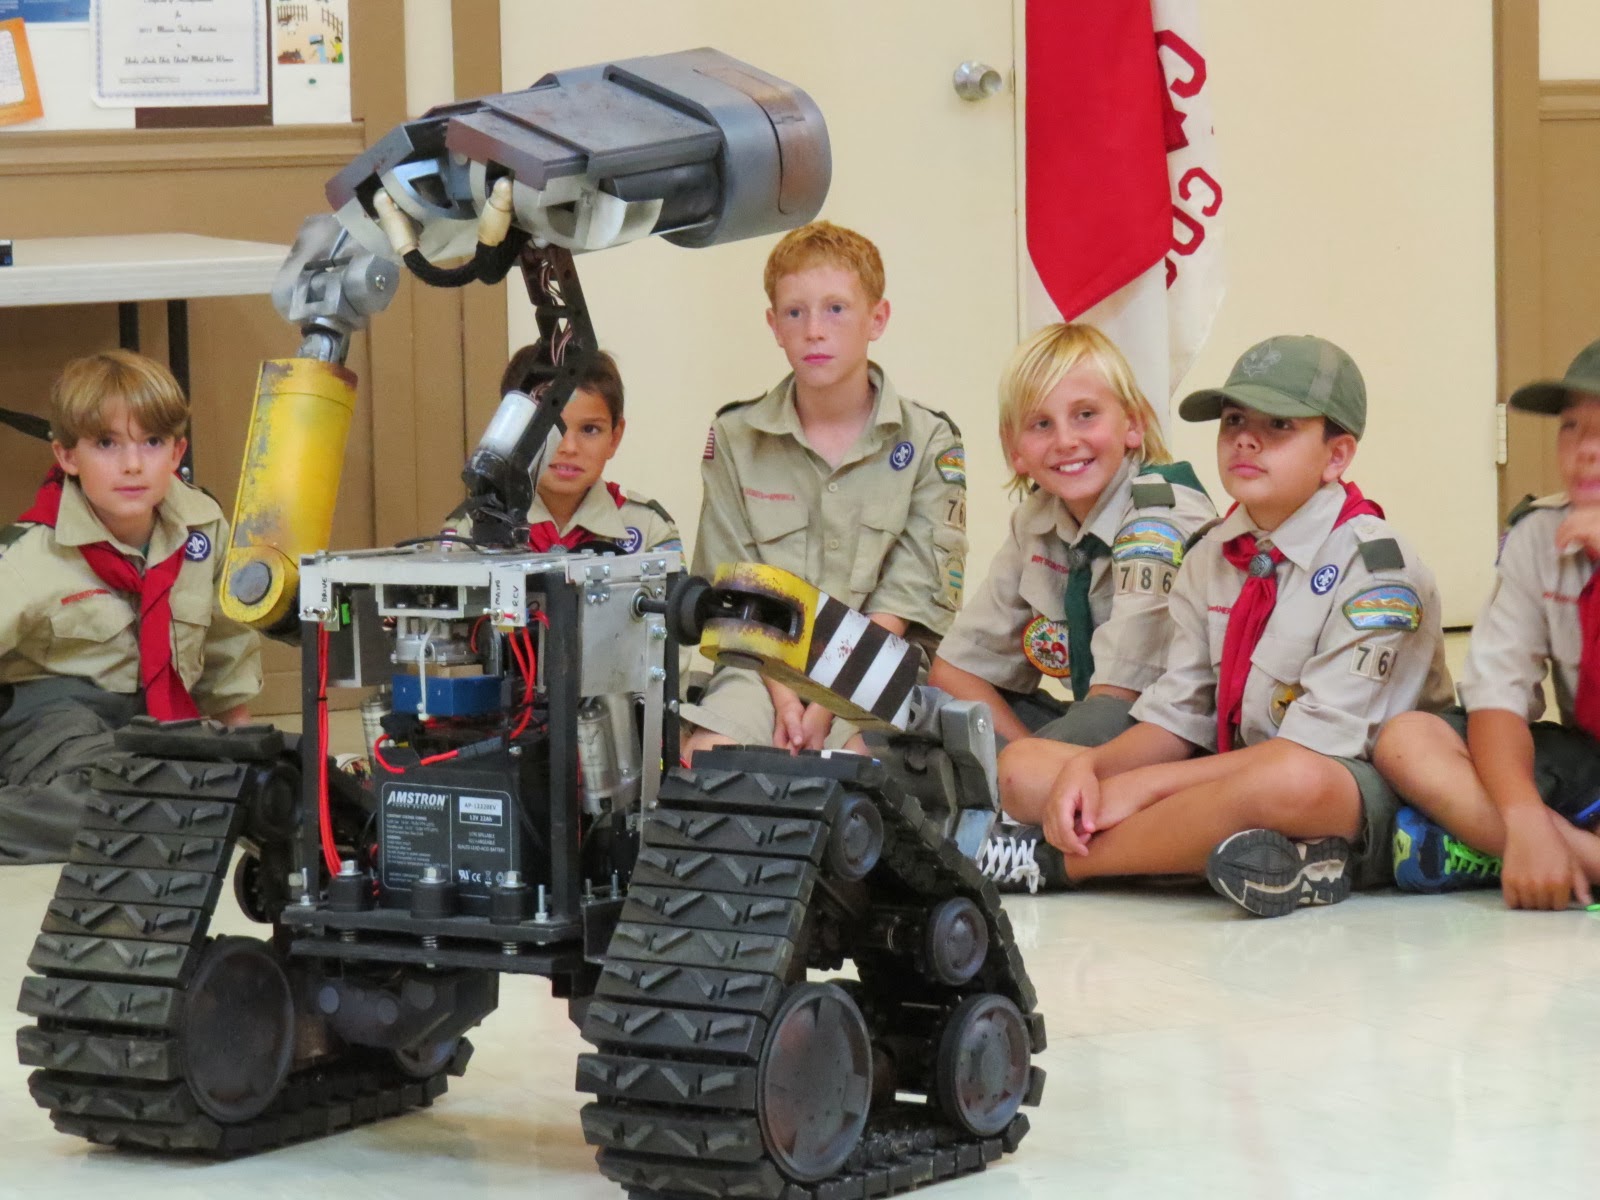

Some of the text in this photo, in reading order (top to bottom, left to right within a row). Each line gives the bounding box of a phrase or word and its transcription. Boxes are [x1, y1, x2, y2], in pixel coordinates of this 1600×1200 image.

[1120, 566, 1172, 594] 786
[1357, 645, 1398, 678] 76
[386, 790, 446, 807] AMSTRON
